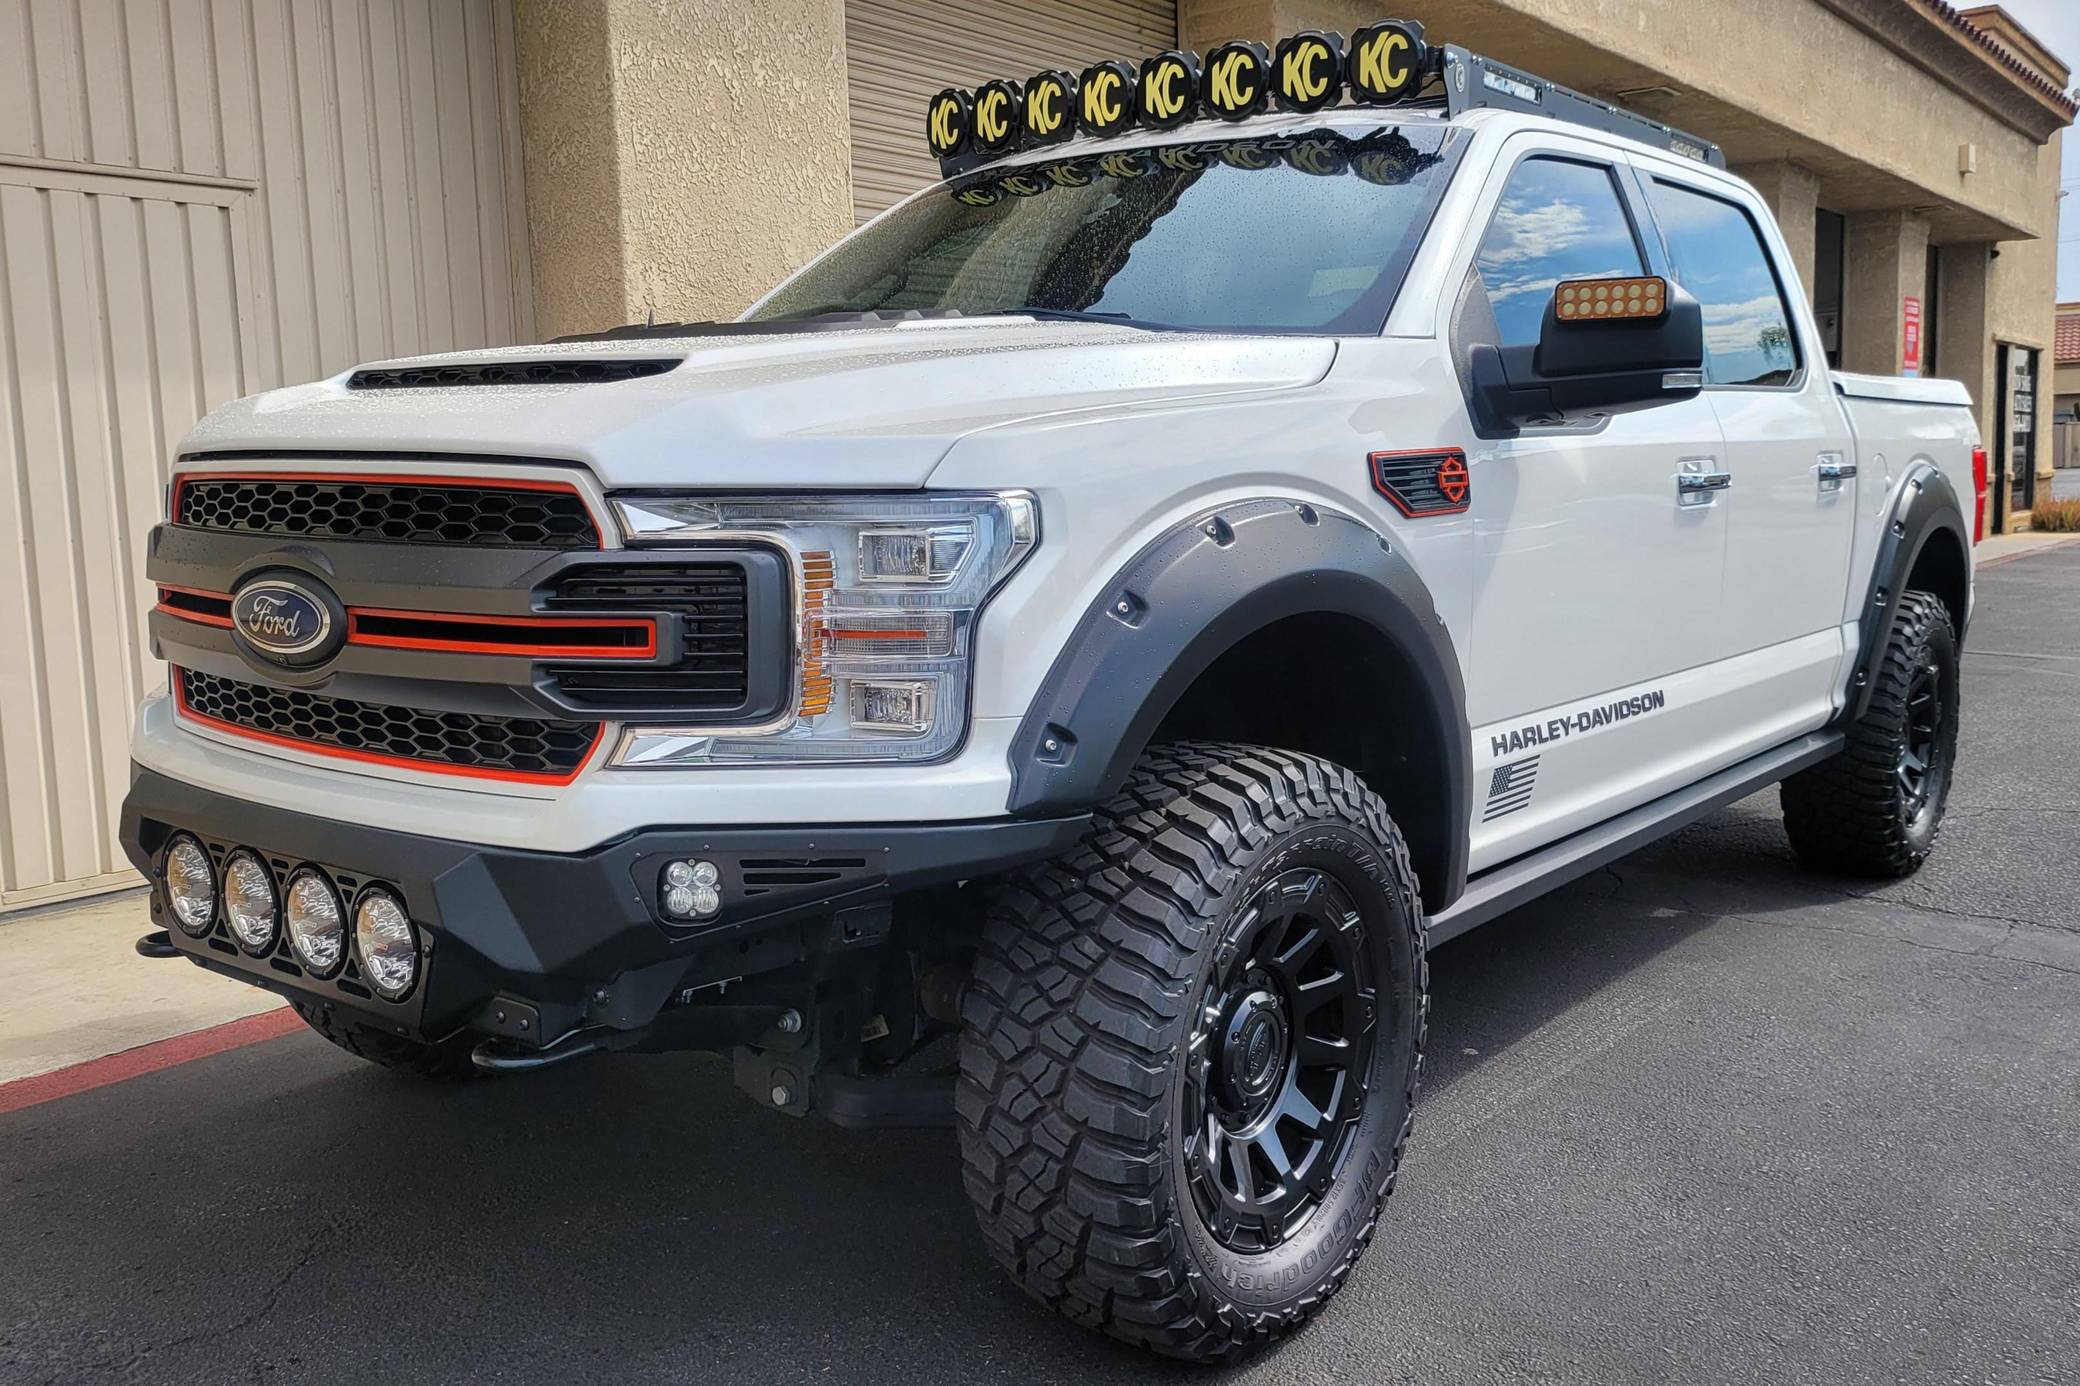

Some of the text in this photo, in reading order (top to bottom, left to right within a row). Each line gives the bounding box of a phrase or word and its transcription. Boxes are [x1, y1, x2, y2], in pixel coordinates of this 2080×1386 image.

[1146, 62, 1185, 119] KC
[1212, 52, 1254, 111] KC
[1283, 41, 1328, 102] KC
[1360, 31, 1409, 94] KC
[931, 98, 958, 149] KC
[977, 89, 1007, 142] KC
[1028, 80, 1062, 135] KC
[1084, 71, 1121, 127] KC
[249, 595, 301, 638] Ford
[1491, 690, 1665, 757] HARLEY-DAVIDSON
